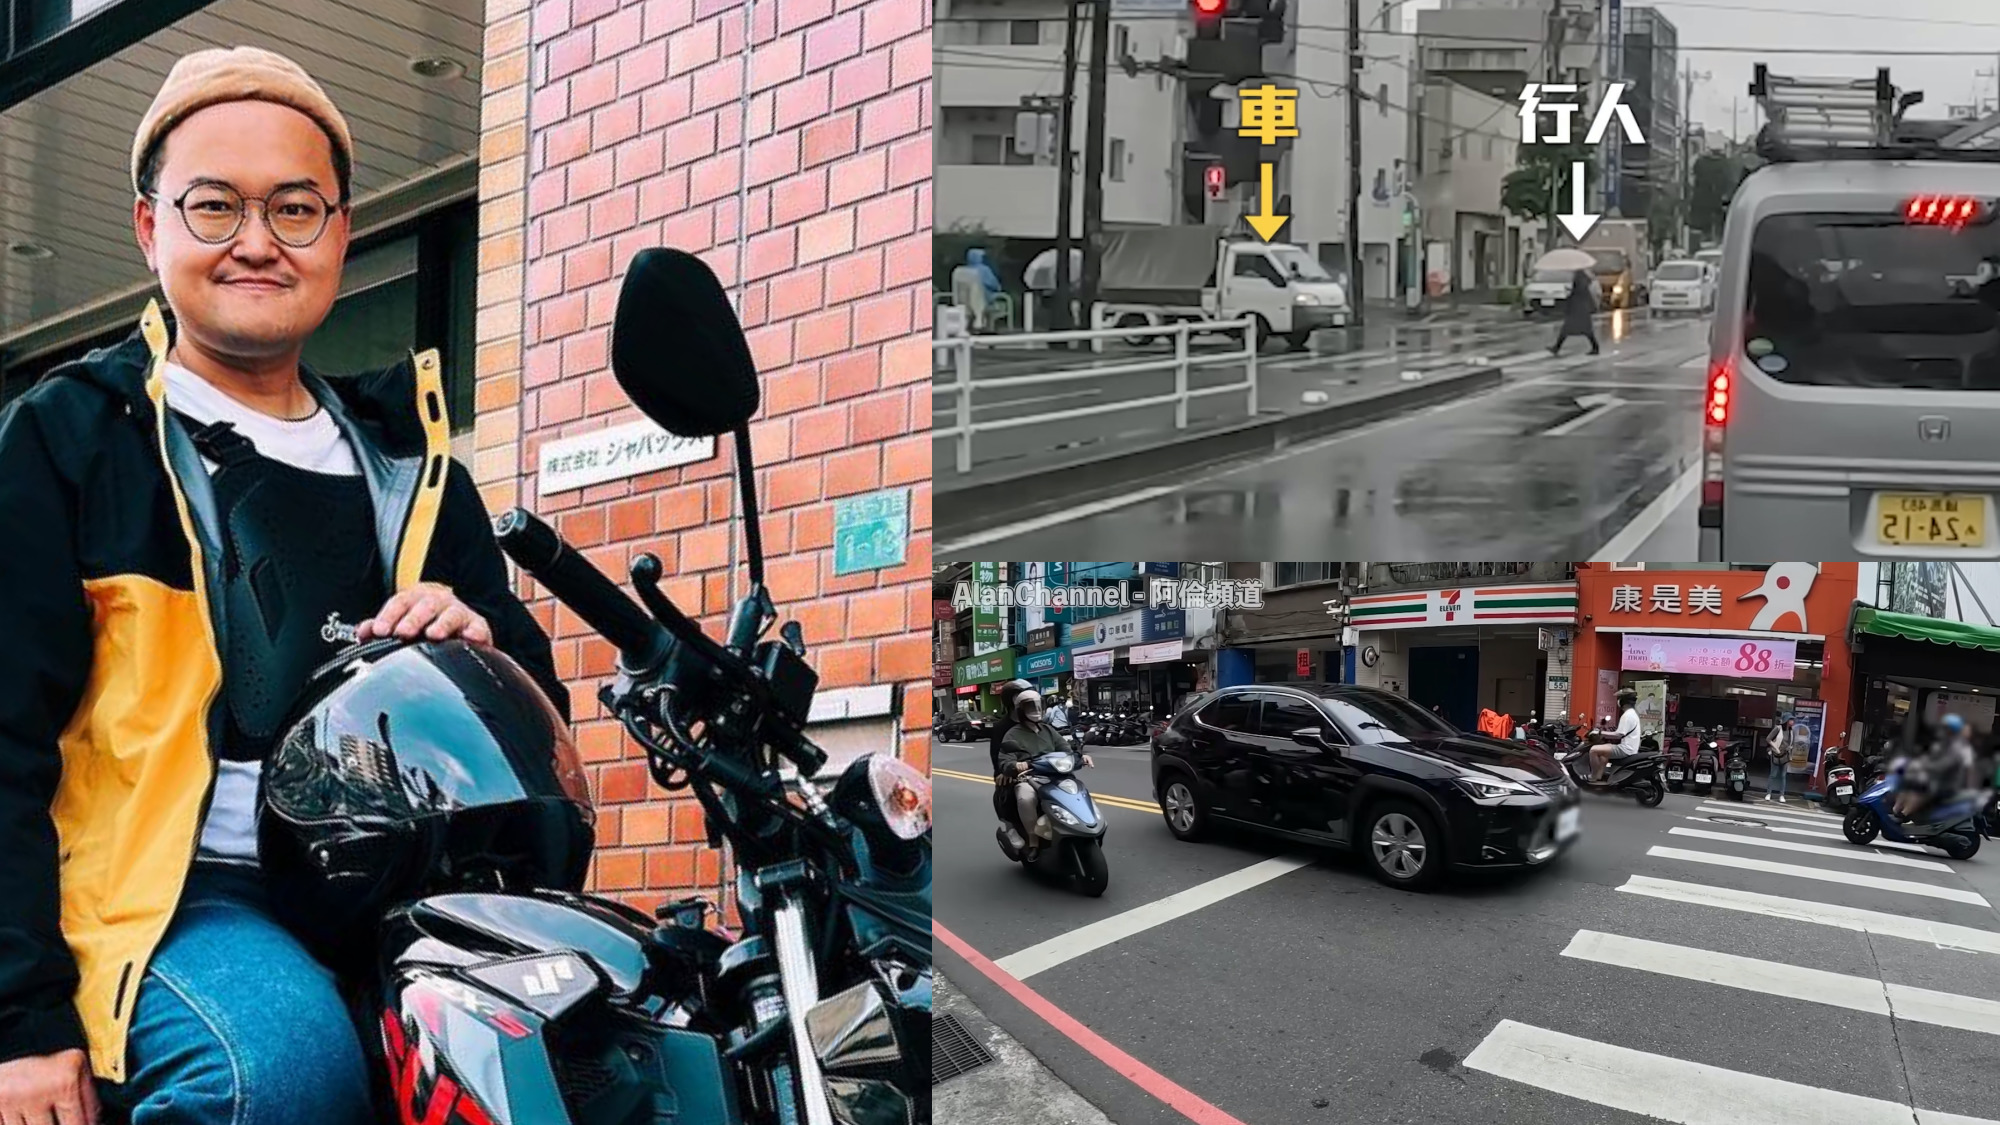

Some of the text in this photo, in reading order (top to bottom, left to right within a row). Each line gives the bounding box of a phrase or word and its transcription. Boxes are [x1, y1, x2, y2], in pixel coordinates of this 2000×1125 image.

[546, 449, 599, 473] 株式会社
[1609, 584, 1722, 615] 康是美
[1298, 652, 1308, 668] 租
[1688, 642, 1785, 673] 不限金額 88 折
